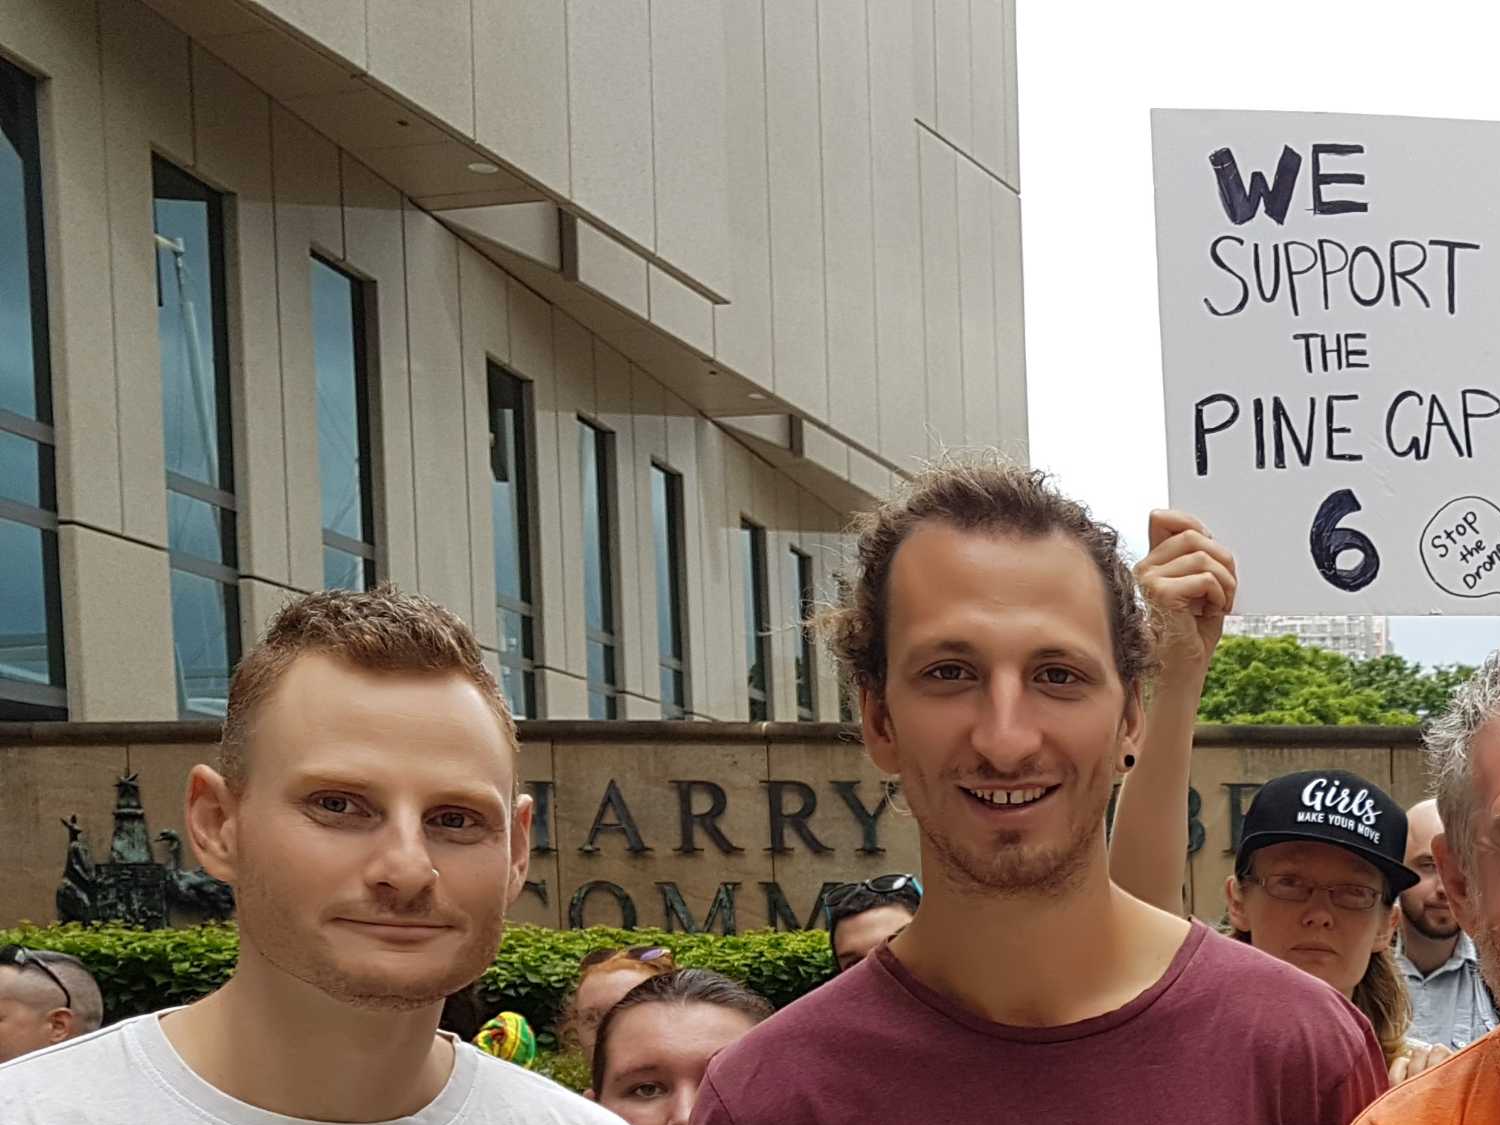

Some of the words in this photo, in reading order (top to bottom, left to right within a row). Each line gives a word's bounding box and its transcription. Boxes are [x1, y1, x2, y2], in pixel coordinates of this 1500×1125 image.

[1208, 143, 1369, 225] WE
[1203, 235, 1481, 316] SUPPORT
[1293, 332, 1370, 373] THE
[1194, 393, 1364, 476] PINE
[1309, 487, 1380, 593] 6
[1431, 511, 1479, 558] Stop
[1459, 539, 1486, 564] the
[1301, 778, 1382, 825] Girls
[1296, 811, 1326, 824] MAKE
[1328, 814, 1356, 831] YOUR
[1357, 822, 1381, 844] MOVE
